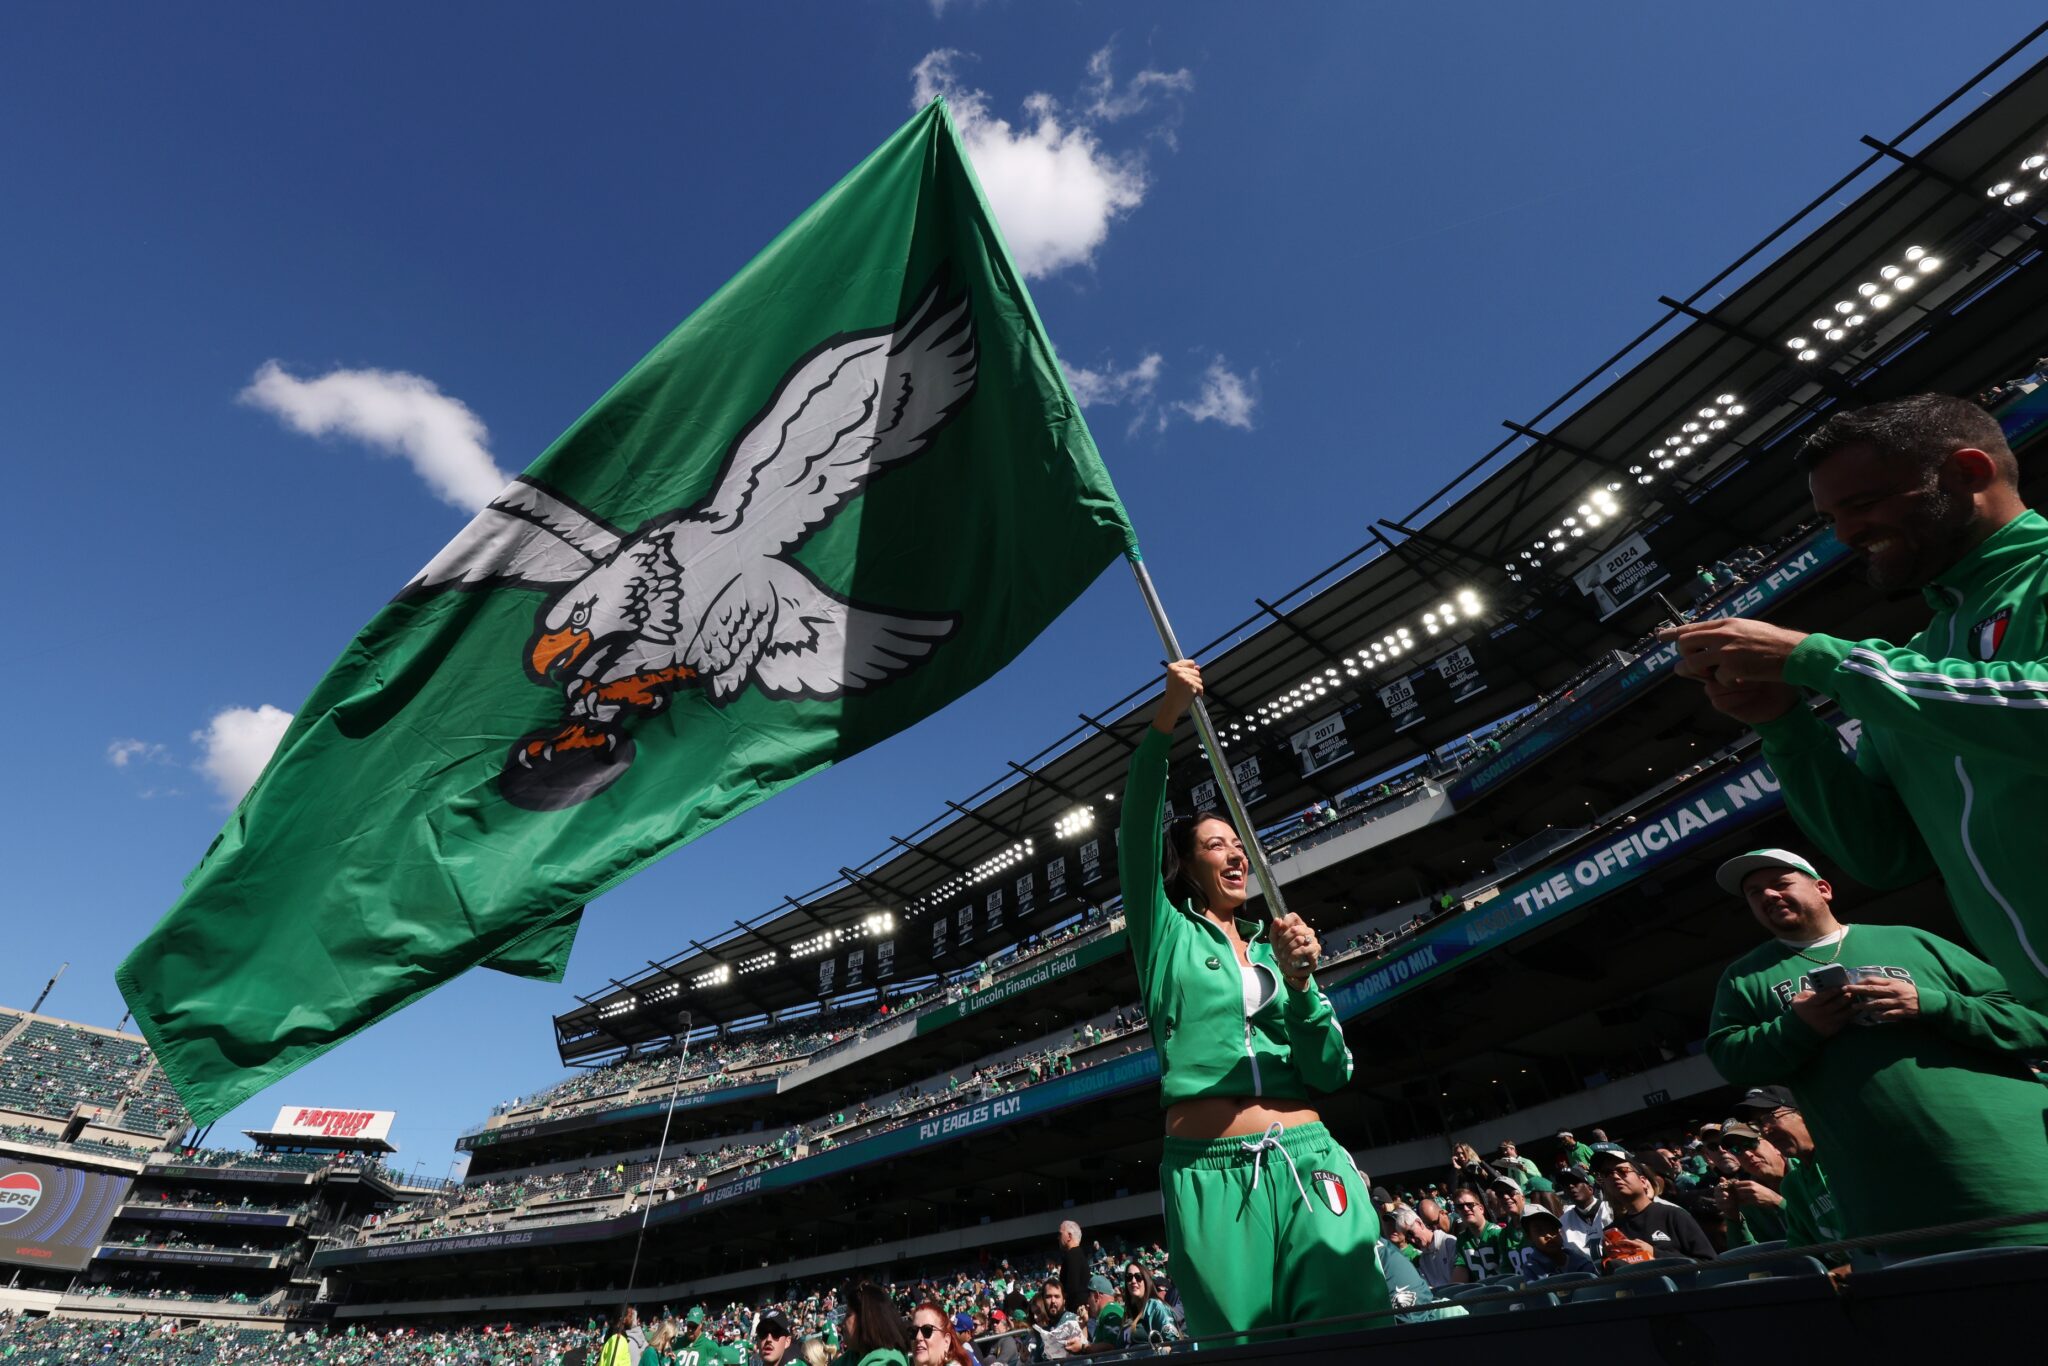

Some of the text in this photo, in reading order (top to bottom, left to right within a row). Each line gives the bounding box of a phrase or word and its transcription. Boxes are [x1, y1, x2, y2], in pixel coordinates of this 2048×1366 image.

[1606, 546, 1638, 573] 2024
[1612, 561, 1658, 595] CHAMPIONS
[1616, 560, 1645, 583] WORLD
[1766, 550, 1819, 591] FLY!
[1444, 657, 1471, 676] 2022
[1387, 688, 1410, 705] 2019
[1315, 723, 1335, 740] 2017
[1315, 739, 1348, 759] CHAMPIONS
[1319, 736, 1339, 750] WORLD
[1239, 767, 1257, 781] 2013
[1513, 872, 1573, 916] THE
[1574, 798, 1727, 887] OFFICIAL
[971, 954, 1077, 1010] Lincoln Financial Field
[1356, 965, 1391, 1001] BORN
[1392, 960, 1409, 985] TO
[1409, 945, 1438, 975] MIX
[659, 1102, 670, 1110] FLY
[293, 1109, 375, 1129] FIRSTRUST
[920, 1096, 1020, 1140] FLY EAGLES FLY!
[1314, 1172, 1341, 1184] ITALIA
[0, 1191, 37, 1207] EPSI
[702, 1177, 761, 1205] FLY EAGLES FLY!
[16, 1247, 52, 1258] verizon
[367, 1249, 379, 1258] THE
[379, 1246, 405, 1256] OFFICIAL
[405, 1244, 432, 1255] NUGGET
[442, 1240, 454, 1250] THE
[454, 1236, 503, 1250] PHILADELPHIA
[504, 1232, 533, 1244] EAGLES
